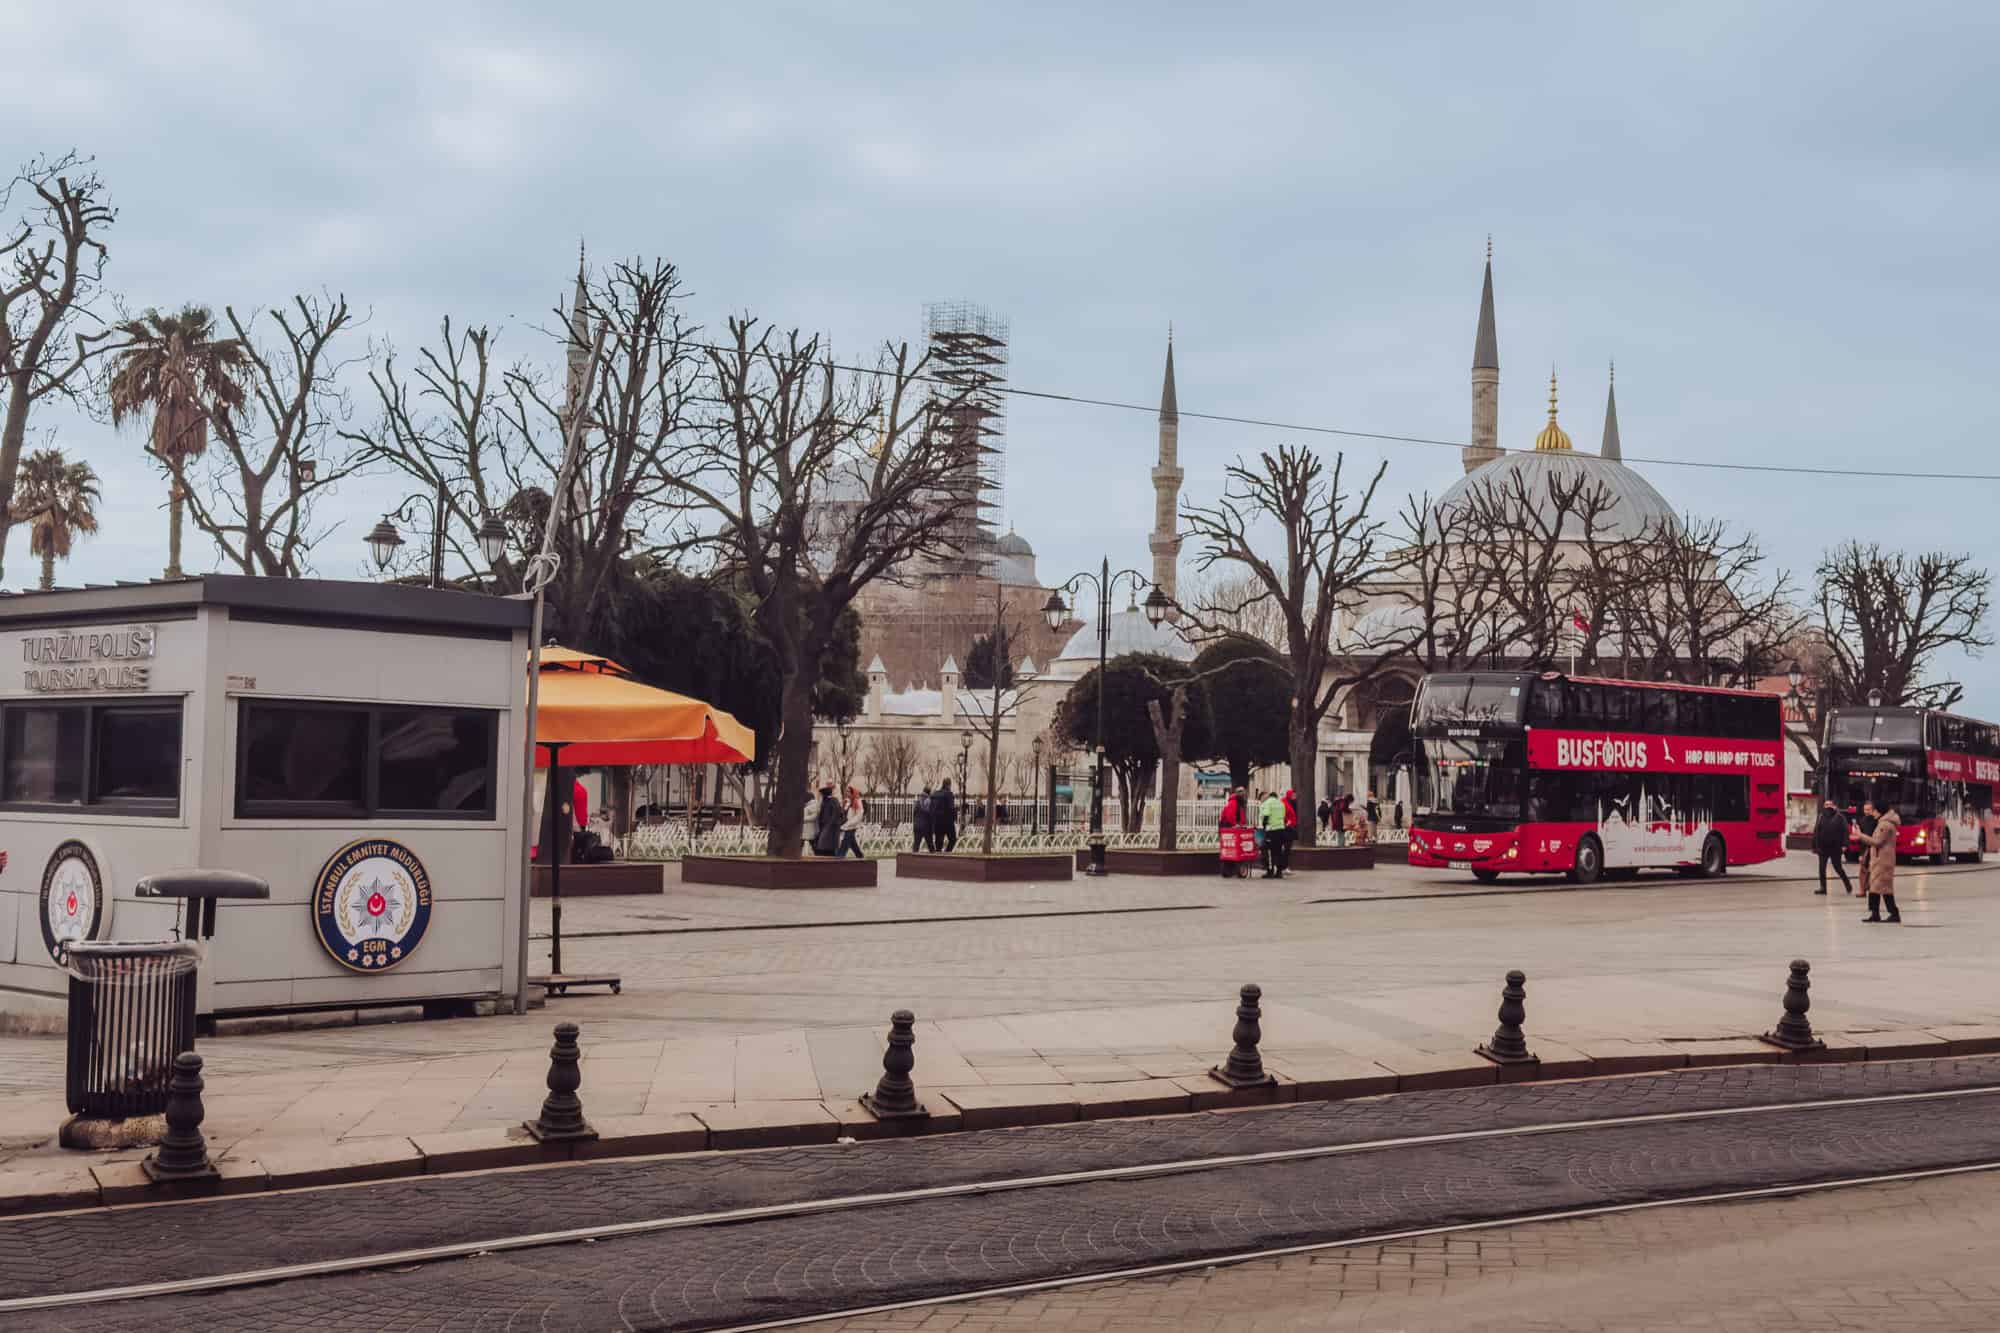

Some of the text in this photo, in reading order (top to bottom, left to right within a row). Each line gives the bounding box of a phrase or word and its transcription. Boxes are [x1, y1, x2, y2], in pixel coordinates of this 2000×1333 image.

[24, 666, 148, 691] TOURISM POLICE
[1557, 736, 1648, 769] BUSFORUS
[1685, 749, 1775, 767] HOP ON HOP OFF TOURS
[319, 862, 349, 915] İSTANBUL
[346, 842, 389, 865] EMNİYET
[363, 940, 387, 953] EGM
